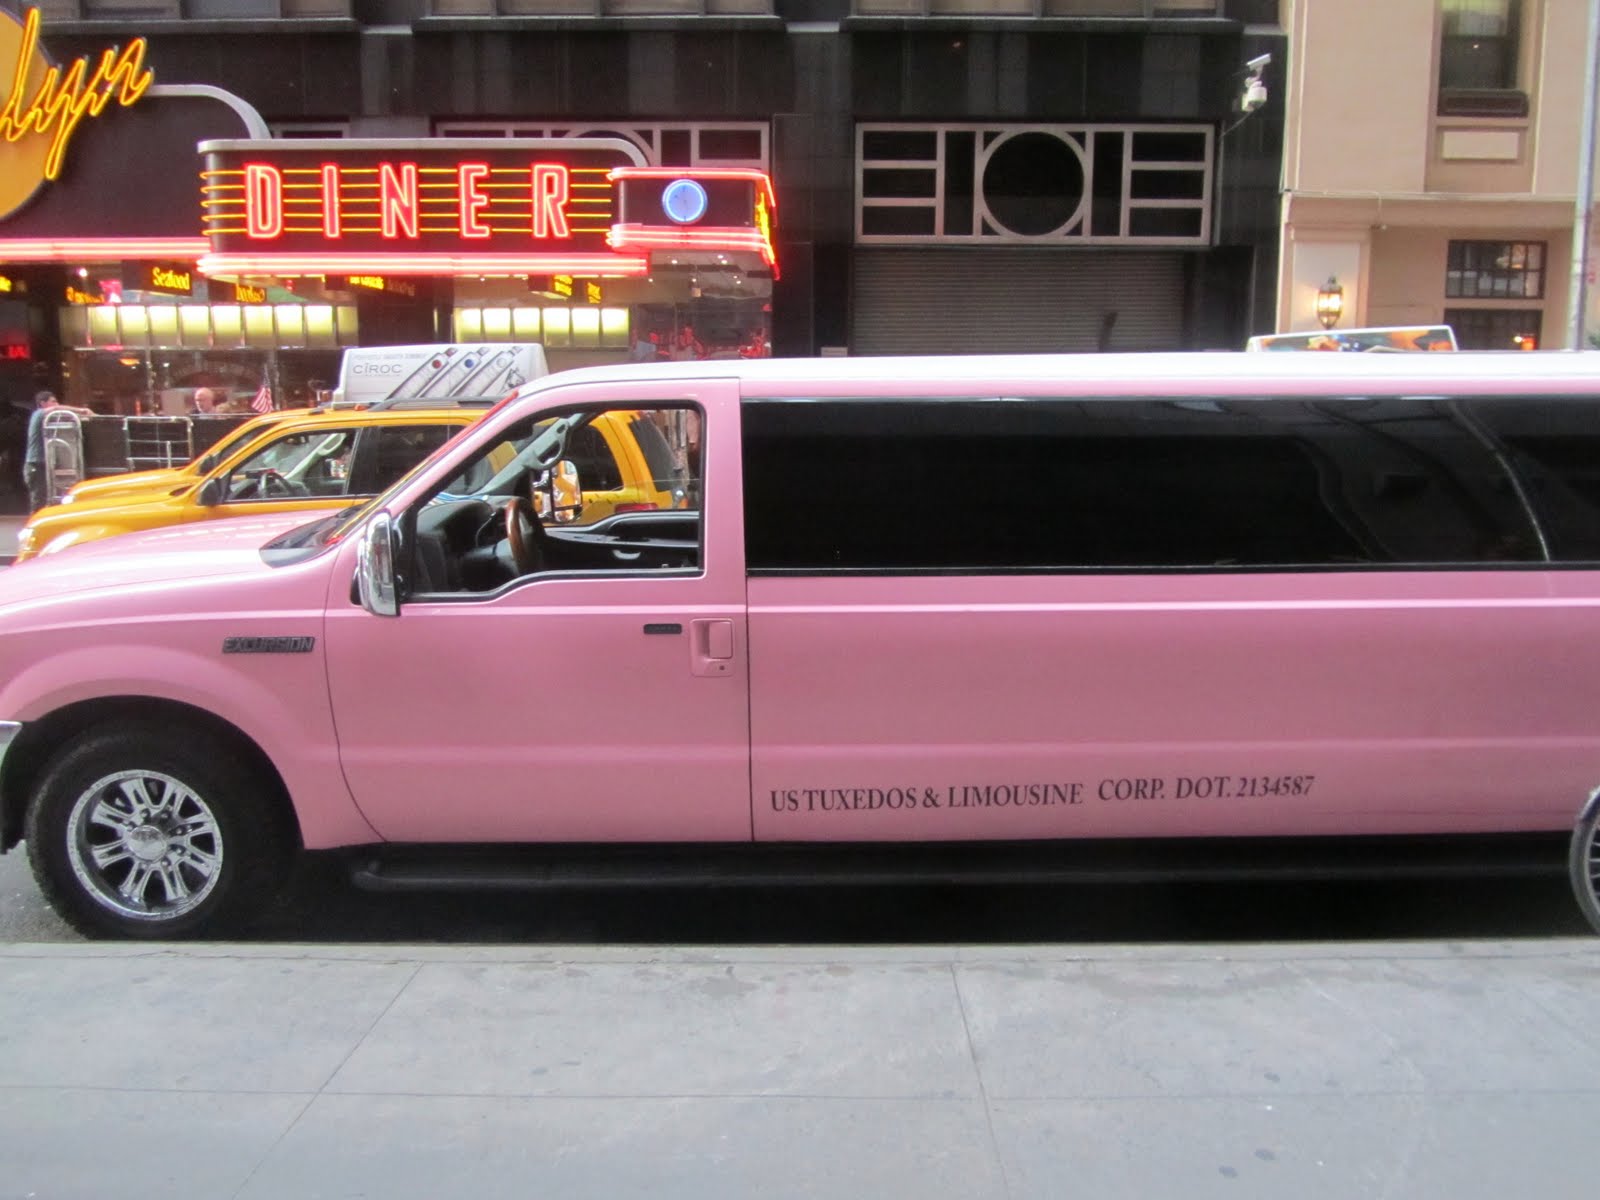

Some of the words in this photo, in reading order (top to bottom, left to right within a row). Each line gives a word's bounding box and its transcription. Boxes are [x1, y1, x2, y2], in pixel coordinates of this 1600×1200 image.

[244, 163, 571, 240] DINER
[152, 266, 190, 290] Seafood
[223, 636, 315, 653] EXCURSION
[770, 789, 799, 812] US
[802, 786, 917, 811] TUXEDOS
[922, 786, 942, 809] &
[948, 782, 1083, 808] LIMOUSINE
[1098, 778, 1165, 801] CORP.
[1175, 776, 1231, 799] DOT.
[1235, 775, 1315, 798] 2134587
